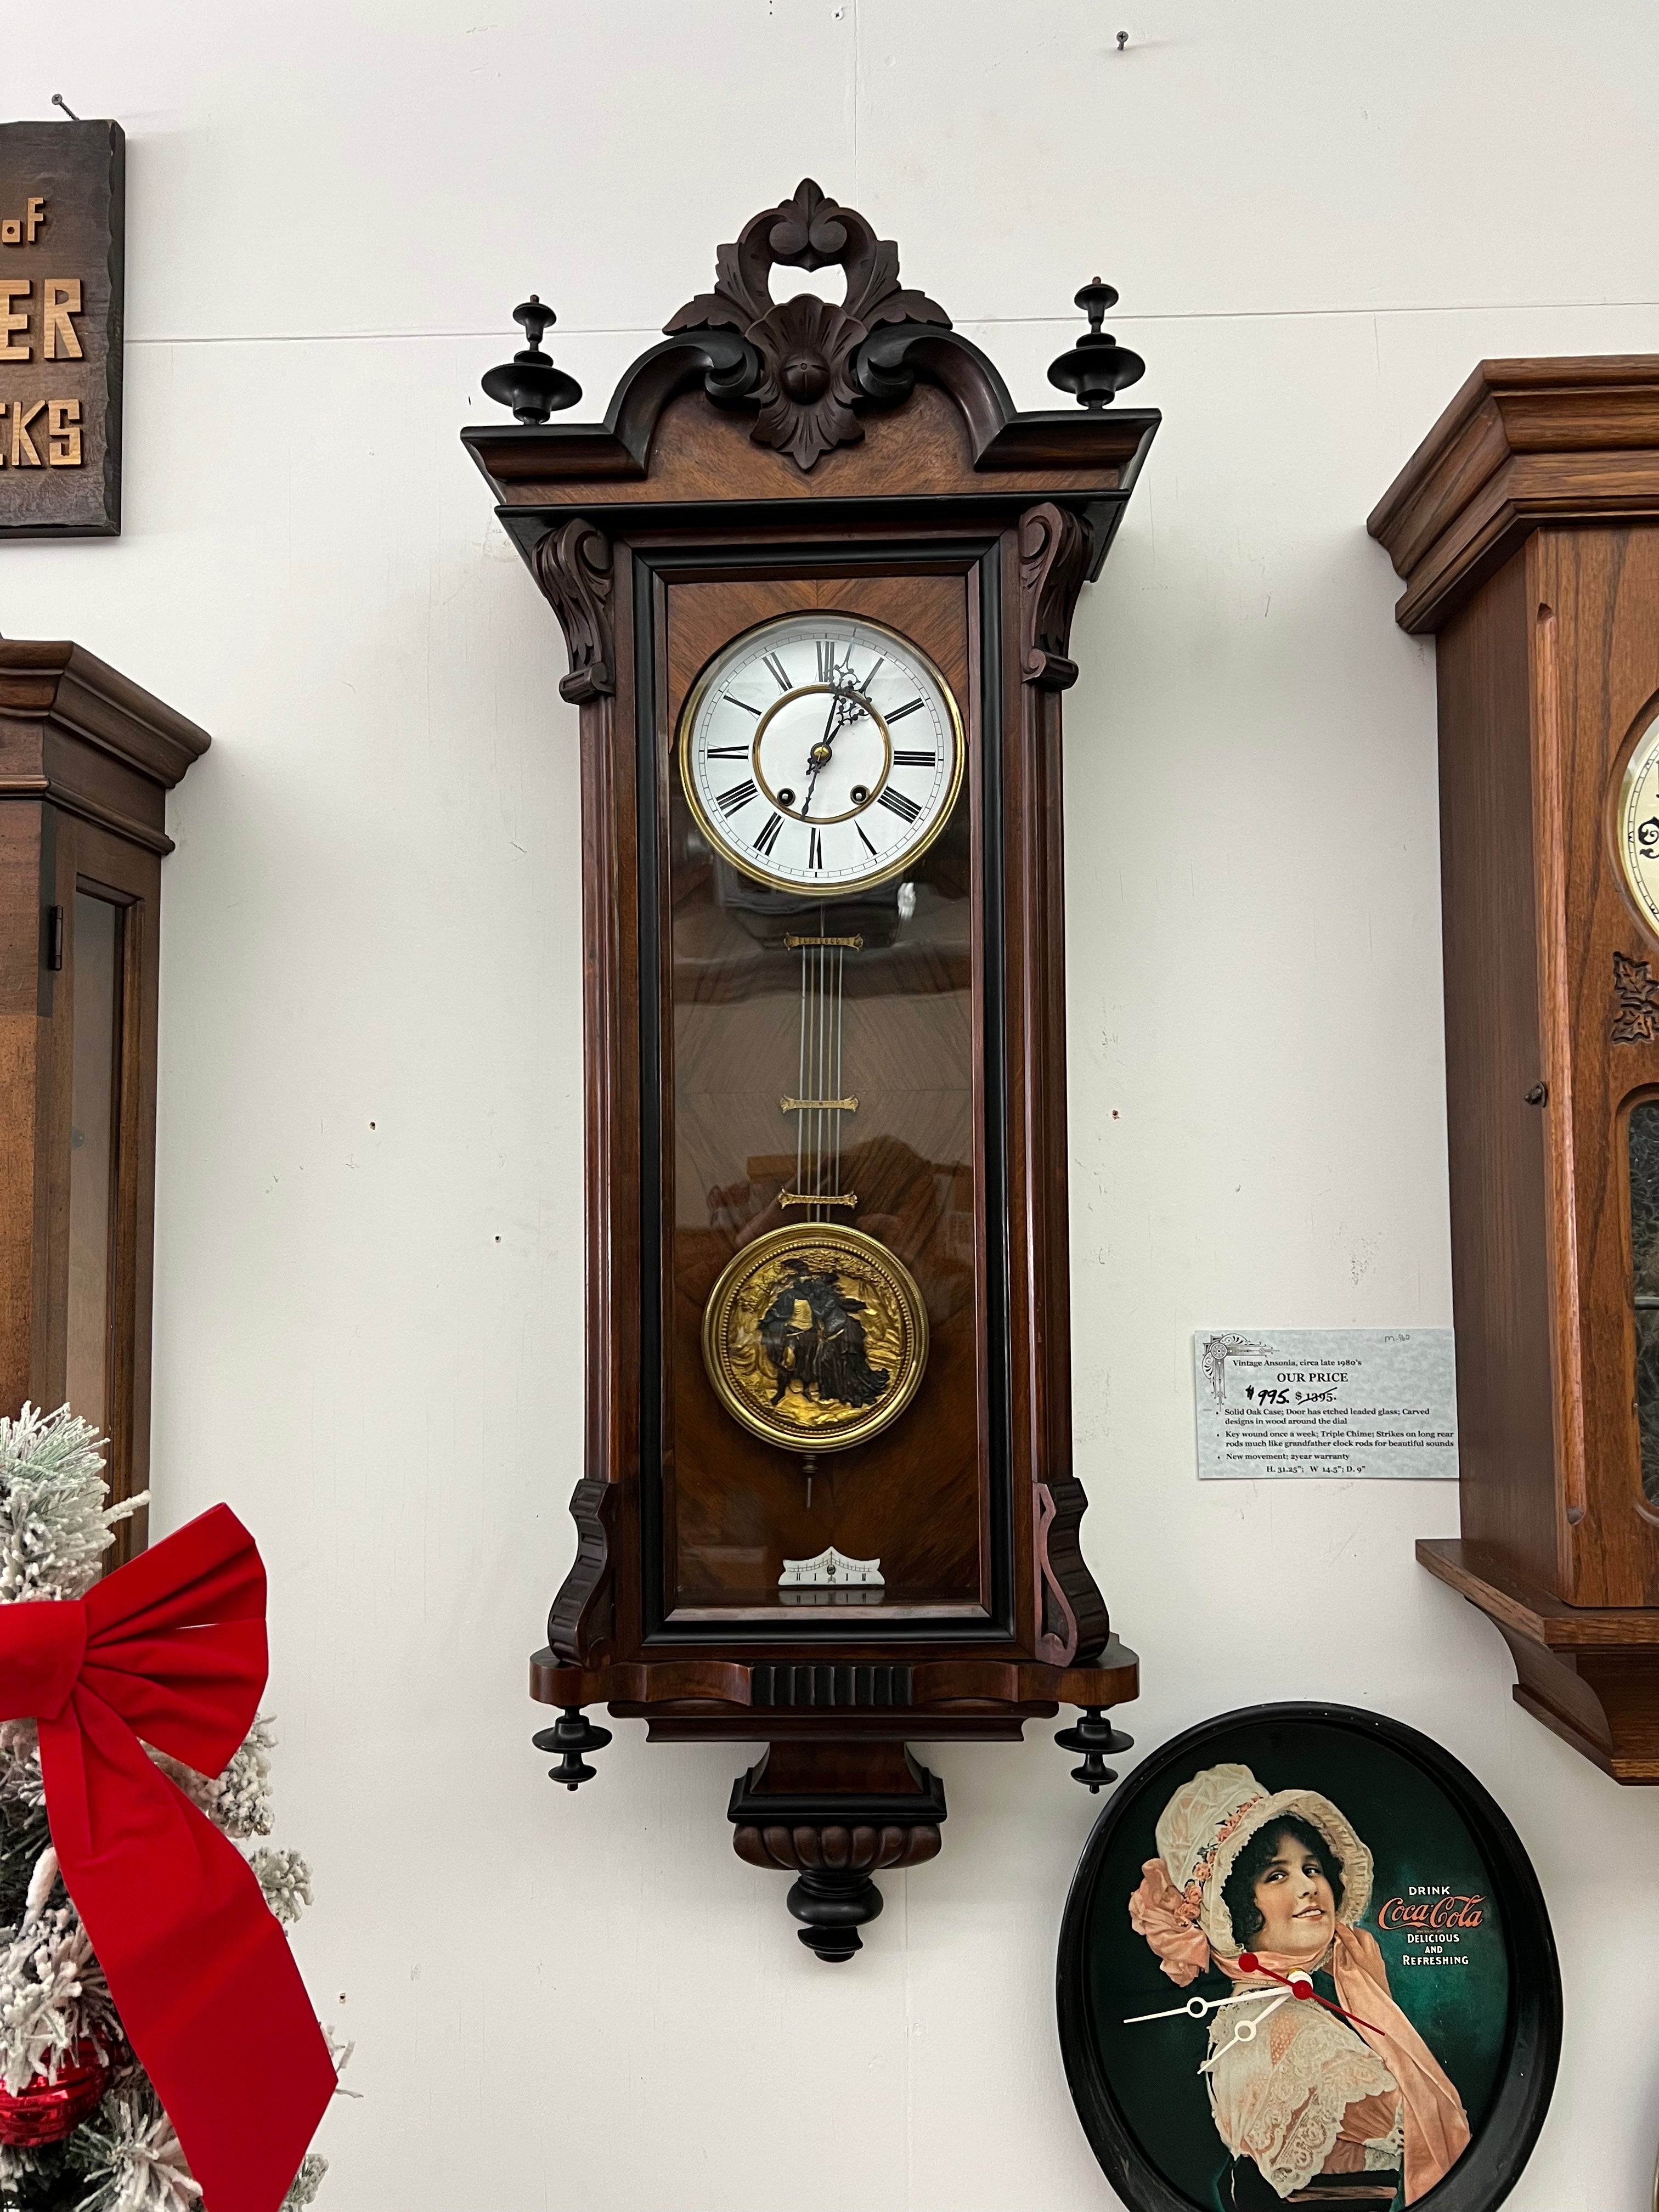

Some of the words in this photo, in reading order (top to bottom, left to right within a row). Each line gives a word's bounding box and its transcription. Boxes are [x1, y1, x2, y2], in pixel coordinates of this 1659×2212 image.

[0, 399, 81, 465] KS
[1277, 1373, 1306, 1383] OUR
[1308, 1373, 1348, 1383] PRICE
[1378, 1408, 1400, 1416] glass;
[1418, 1430, 1435, 1438] long
[1408, 1886, 1451, 1895] DRINK
[1378, 1894, 1487, 1930] Coca-Cola
[1407, 1933, 1460, 1943] DELICIOUS
[1424, 1945, 1443, 1954] AND
[1402, 1955, 1469, 1966] REFRESHING
